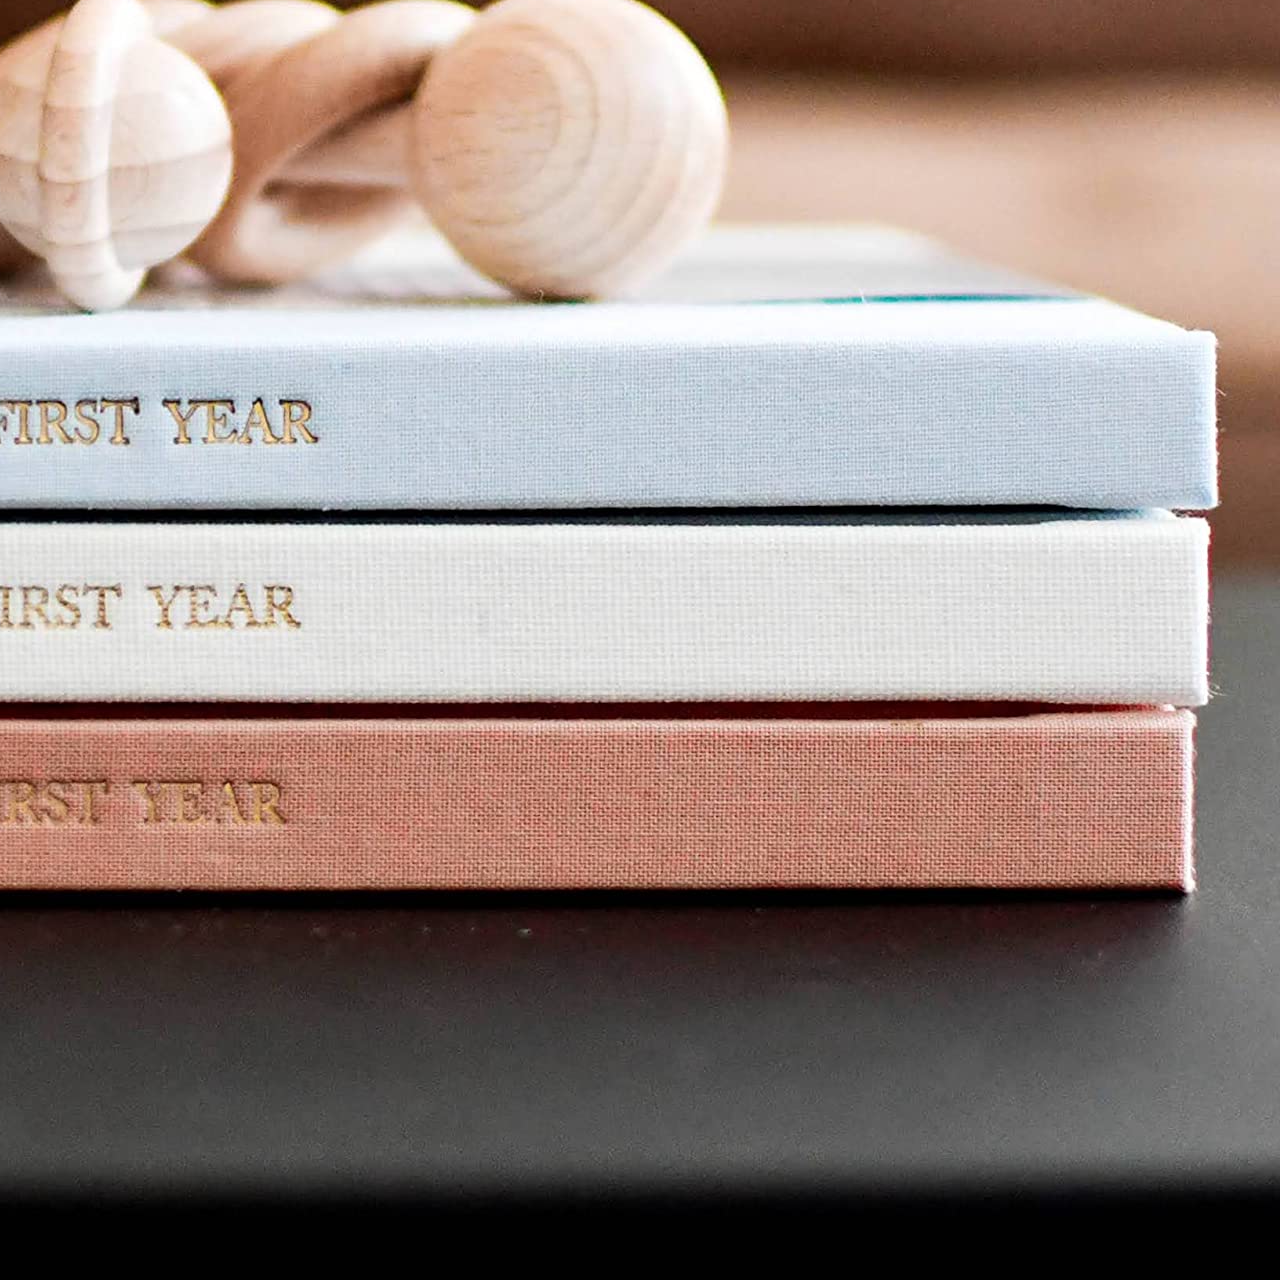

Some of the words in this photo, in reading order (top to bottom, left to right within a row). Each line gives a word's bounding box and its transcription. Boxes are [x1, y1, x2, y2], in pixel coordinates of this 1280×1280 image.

[162, 397, 319, 444] YEAR
[146, 582, 302, 629] YEAR
[131, 779, 287, 824] YEAR
